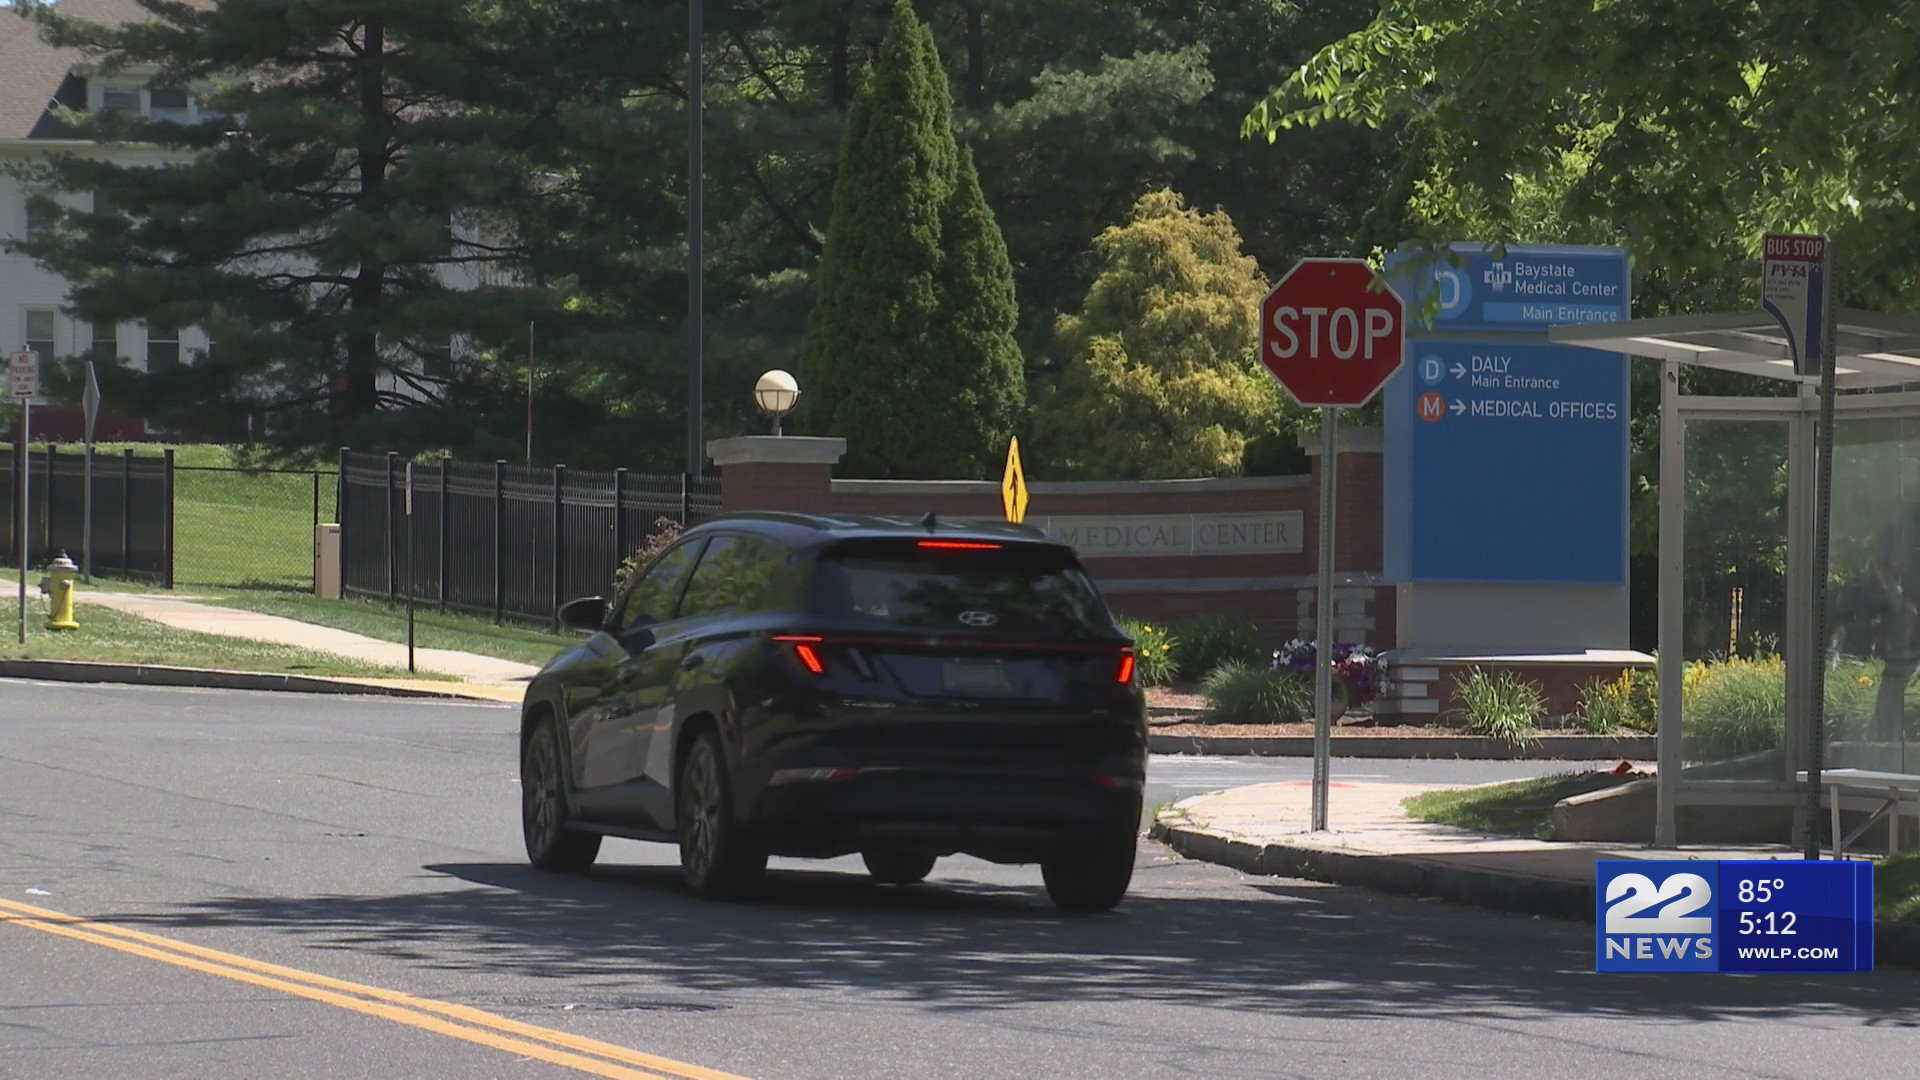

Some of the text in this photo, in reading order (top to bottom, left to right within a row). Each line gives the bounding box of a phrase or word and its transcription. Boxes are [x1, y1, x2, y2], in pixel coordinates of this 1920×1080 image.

[1767, 239, 1822, 256] BUS STOP
[1515, 262, 1575, 279] Baystate
[1771, 263, 1807, 277] PVTA
[1515, 281, 1618, 296] Medical Center
[1523, 307, 1617, 322] Main Entrance
[1270, 306, 1394, 360] STOP
[1426, 356, 1511, 380] D DALY
[1472, 376, 1560, 389] Main Entrance
[1424, 397, 1617, 419] M MEDICAL OFFICES
[1059, 522, 1288, 547] MEDICAL CENTER
